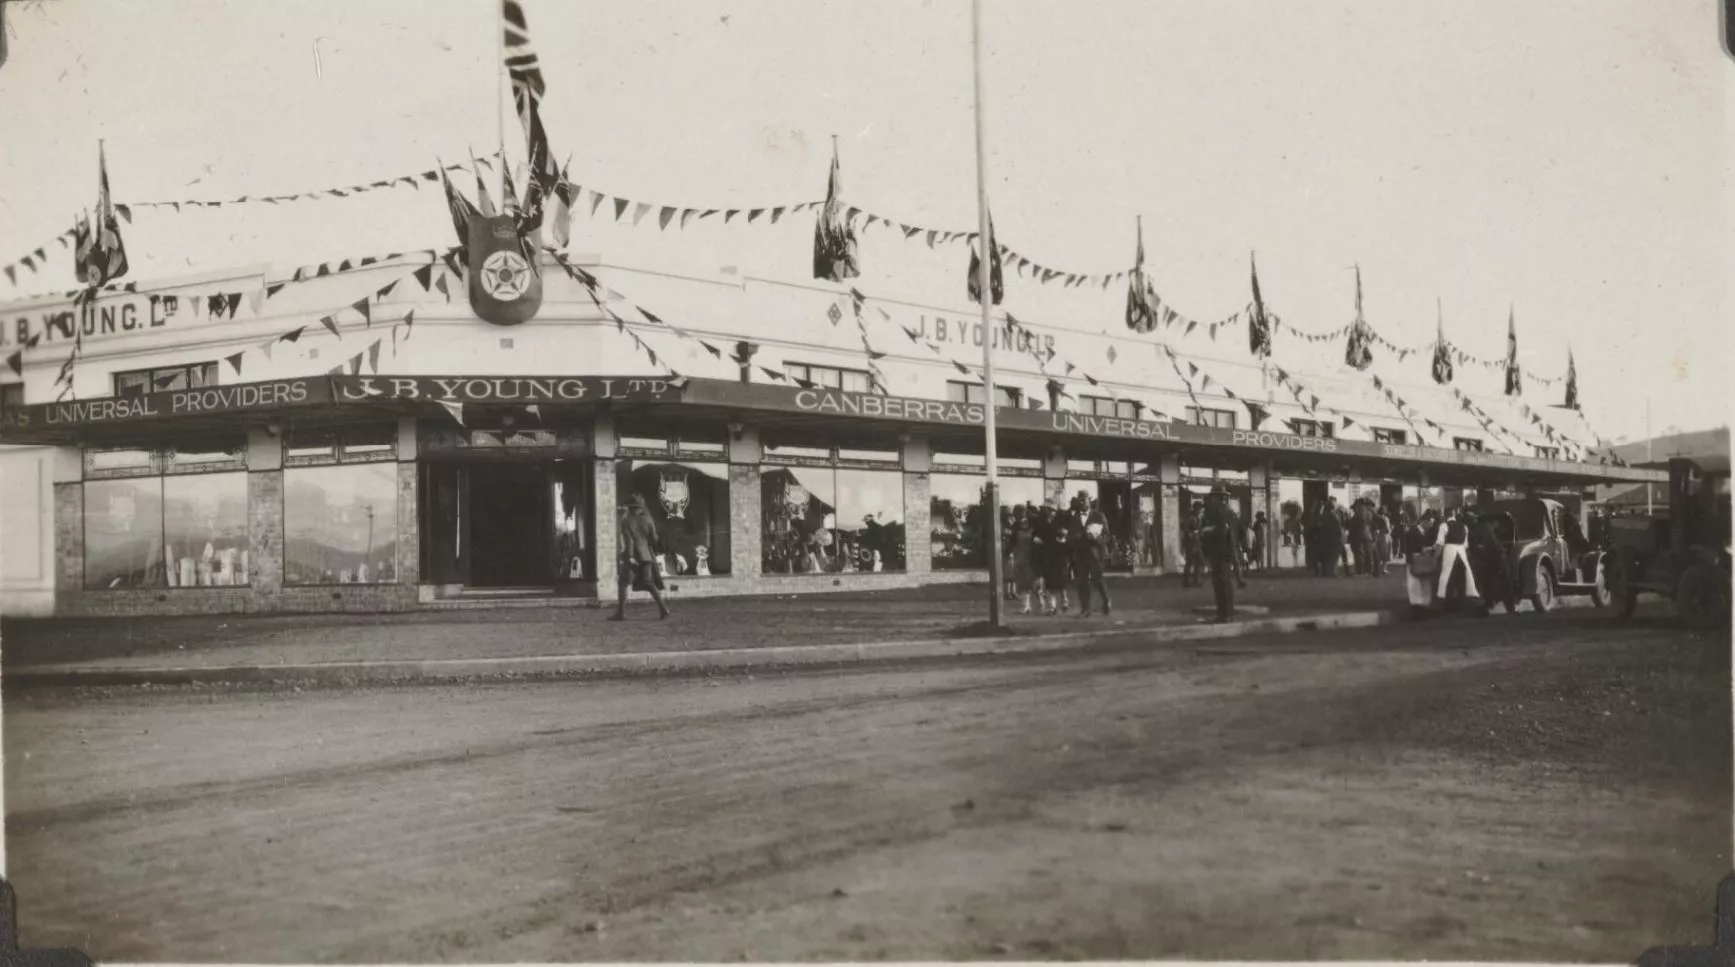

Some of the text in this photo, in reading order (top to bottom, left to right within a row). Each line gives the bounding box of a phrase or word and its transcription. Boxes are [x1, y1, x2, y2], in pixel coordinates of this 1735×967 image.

[45, 396, 158, 424] UNIVERSAL
[172, 381, 307, 413] PROVIDERS
[795, 390, 1337, 451] CANBERRA'S UNIVERSAL PROVIDERS
